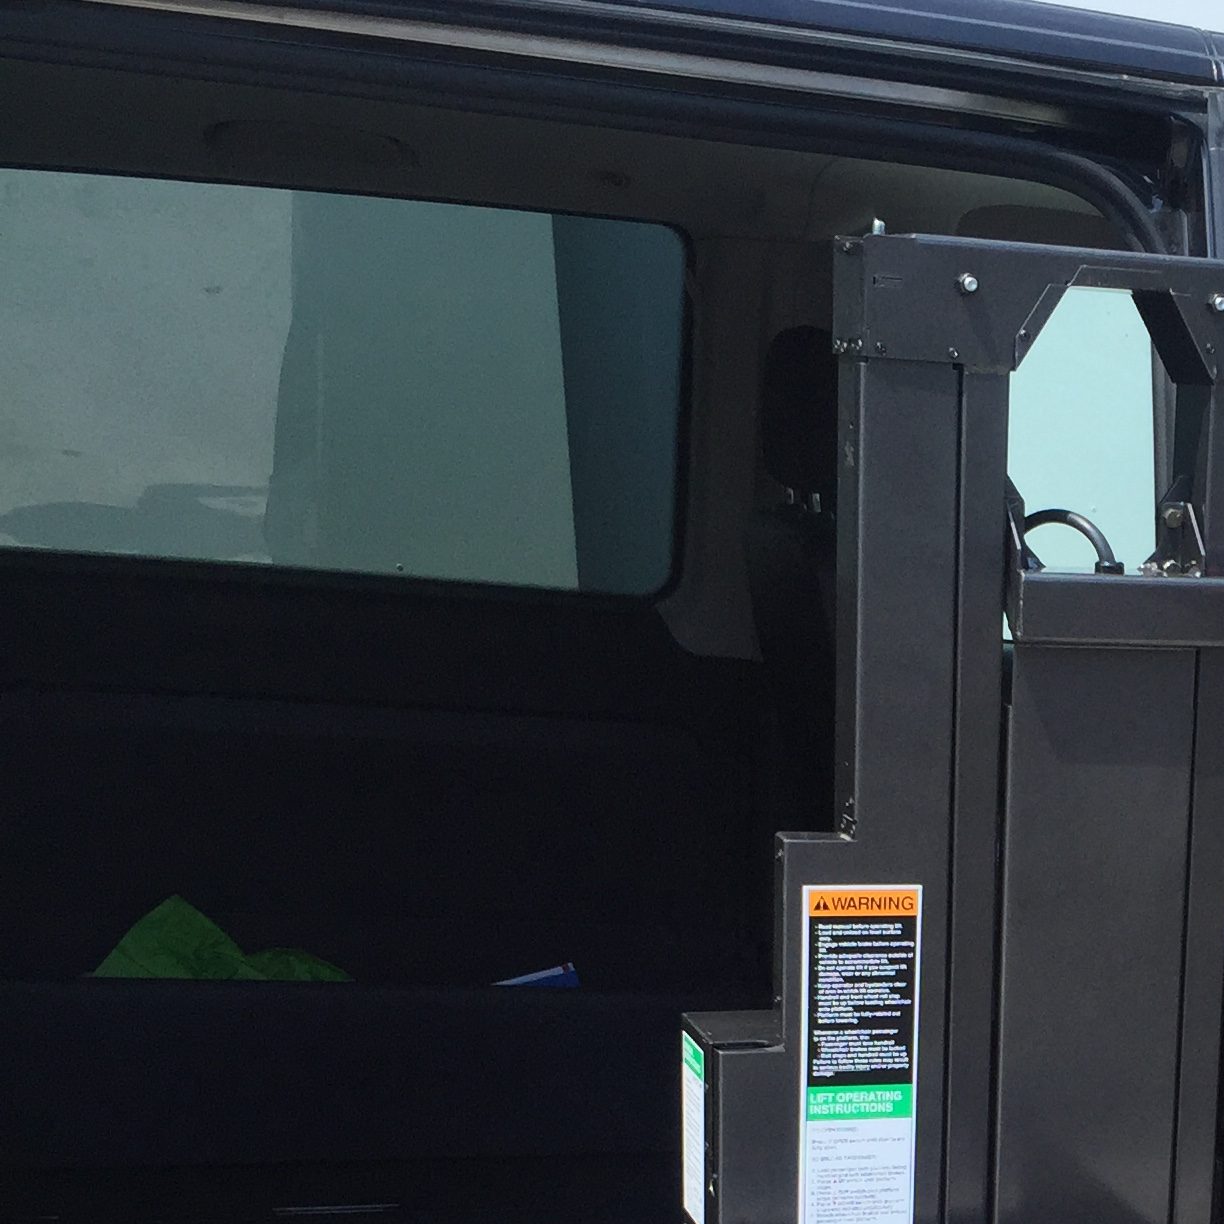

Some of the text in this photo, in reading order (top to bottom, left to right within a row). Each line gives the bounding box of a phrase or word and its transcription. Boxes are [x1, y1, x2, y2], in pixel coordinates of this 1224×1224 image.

[831, 895, 914, 912] WARNING
[809, 1090, 903, 1104] LIFT OPERATING
[809, 1102, 894, 1115] INSTRUCTIONS
